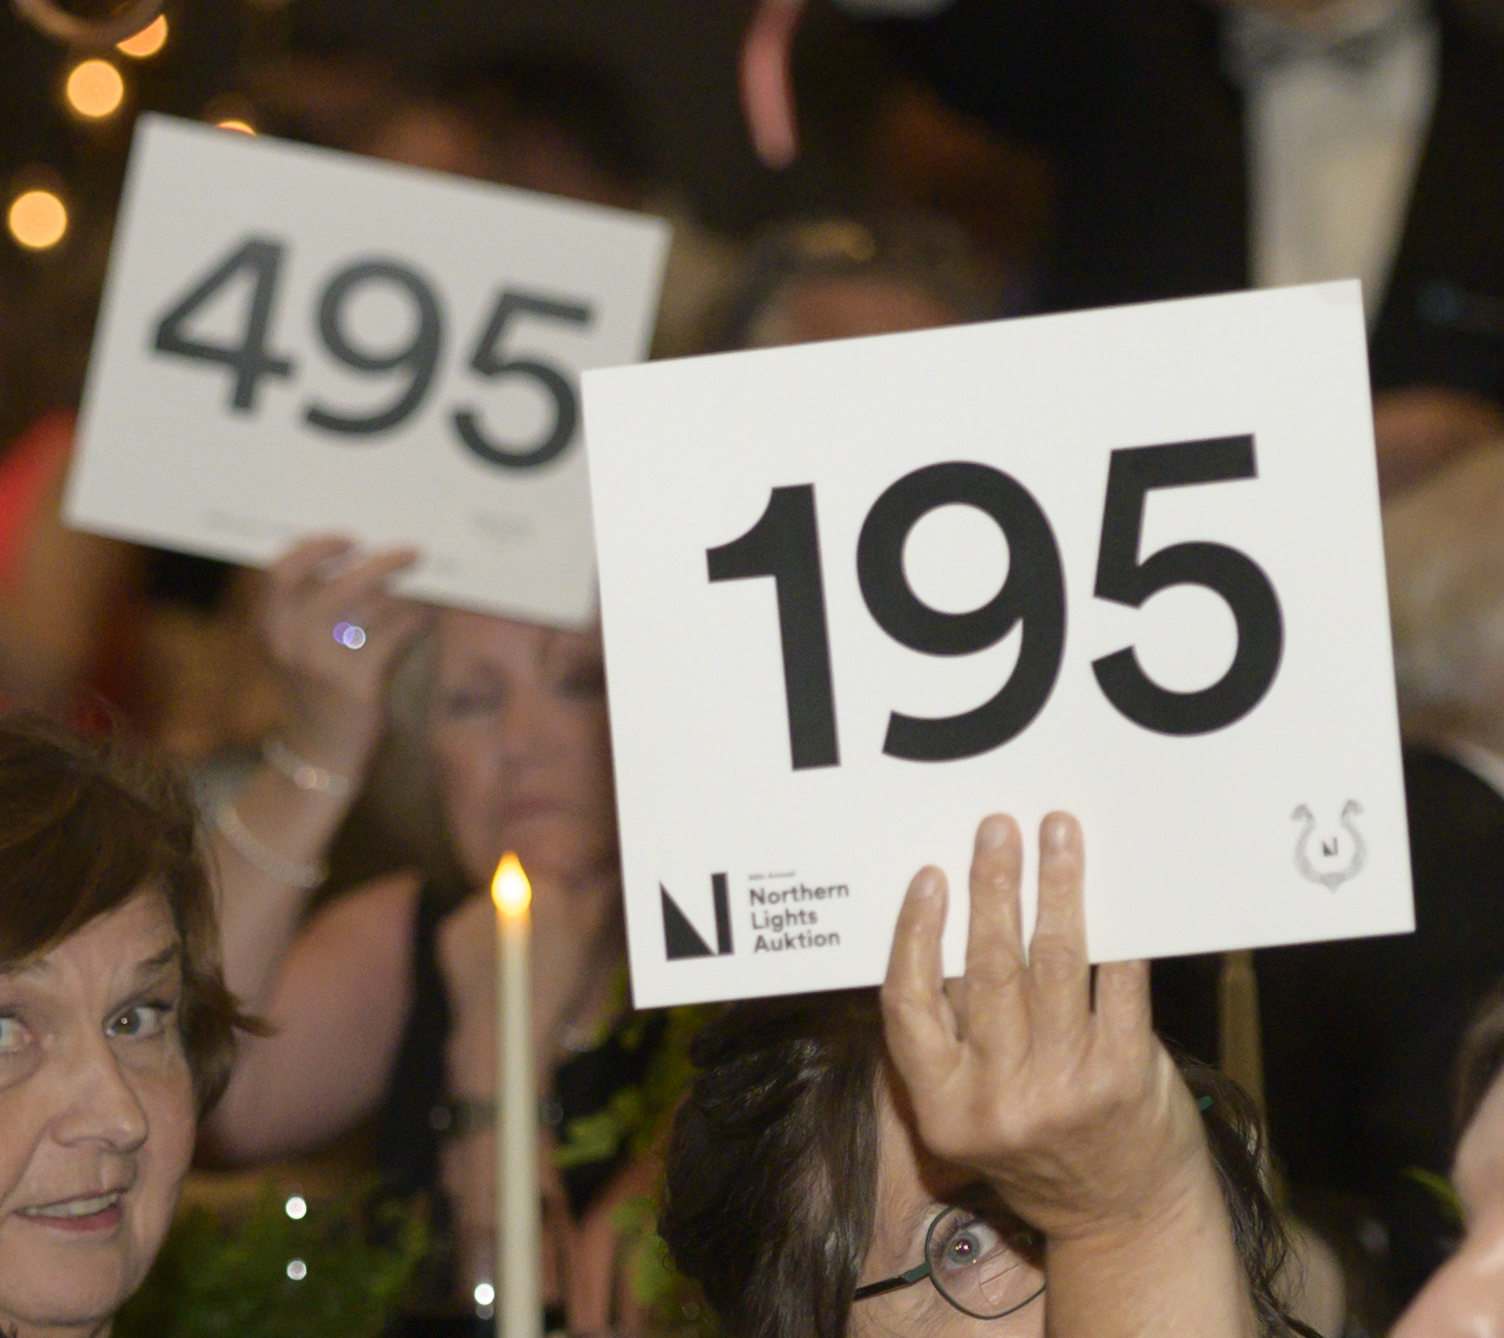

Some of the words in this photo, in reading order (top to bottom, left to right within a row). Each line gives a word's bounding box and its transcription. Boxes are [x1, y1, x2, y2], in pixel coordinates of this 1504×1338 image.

[147, 233, 594, 476] 495
[704, 434, 1285, 771] 195
[749, 883, 849, 907] Northern
[751, 910, 818, 932] Lights
[754, 930, 841, 954] Auktion
